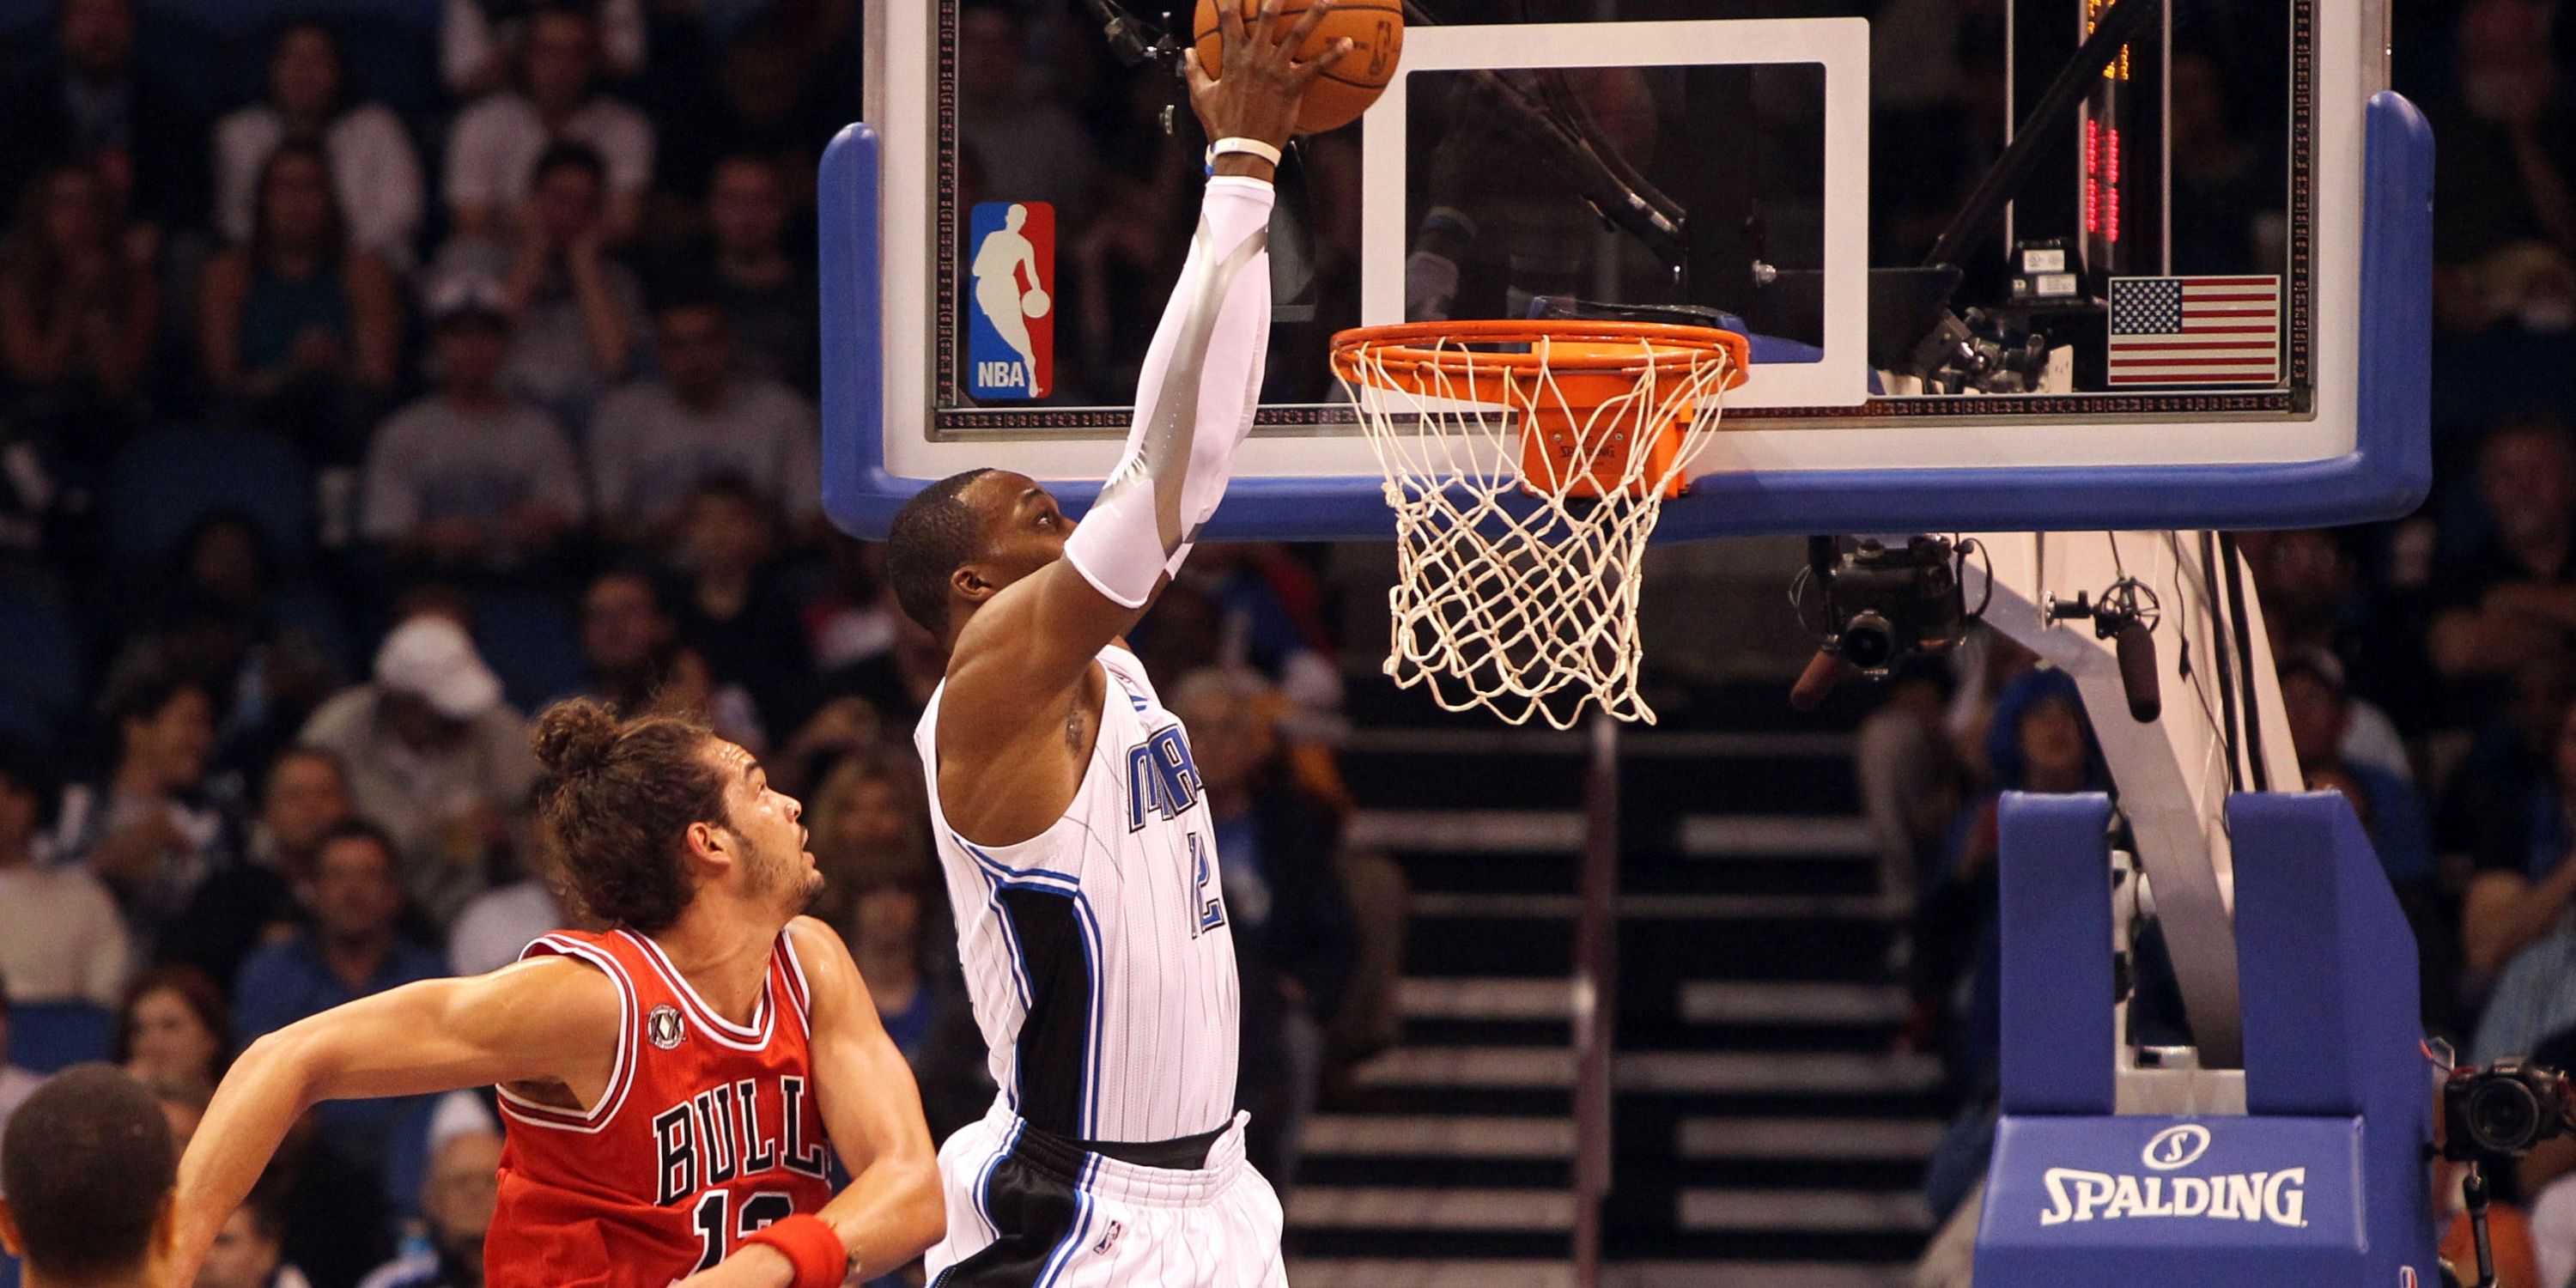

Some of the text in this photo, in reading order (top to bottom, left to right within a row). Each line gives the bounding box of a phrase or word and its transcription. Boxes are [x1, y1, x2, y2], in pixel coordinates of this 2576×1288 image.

[978, 361, 1024, 387] NBA
[653, 1075, 832, 1207] BULL
[2040, 1167, 2306, 1227] SPALDING
